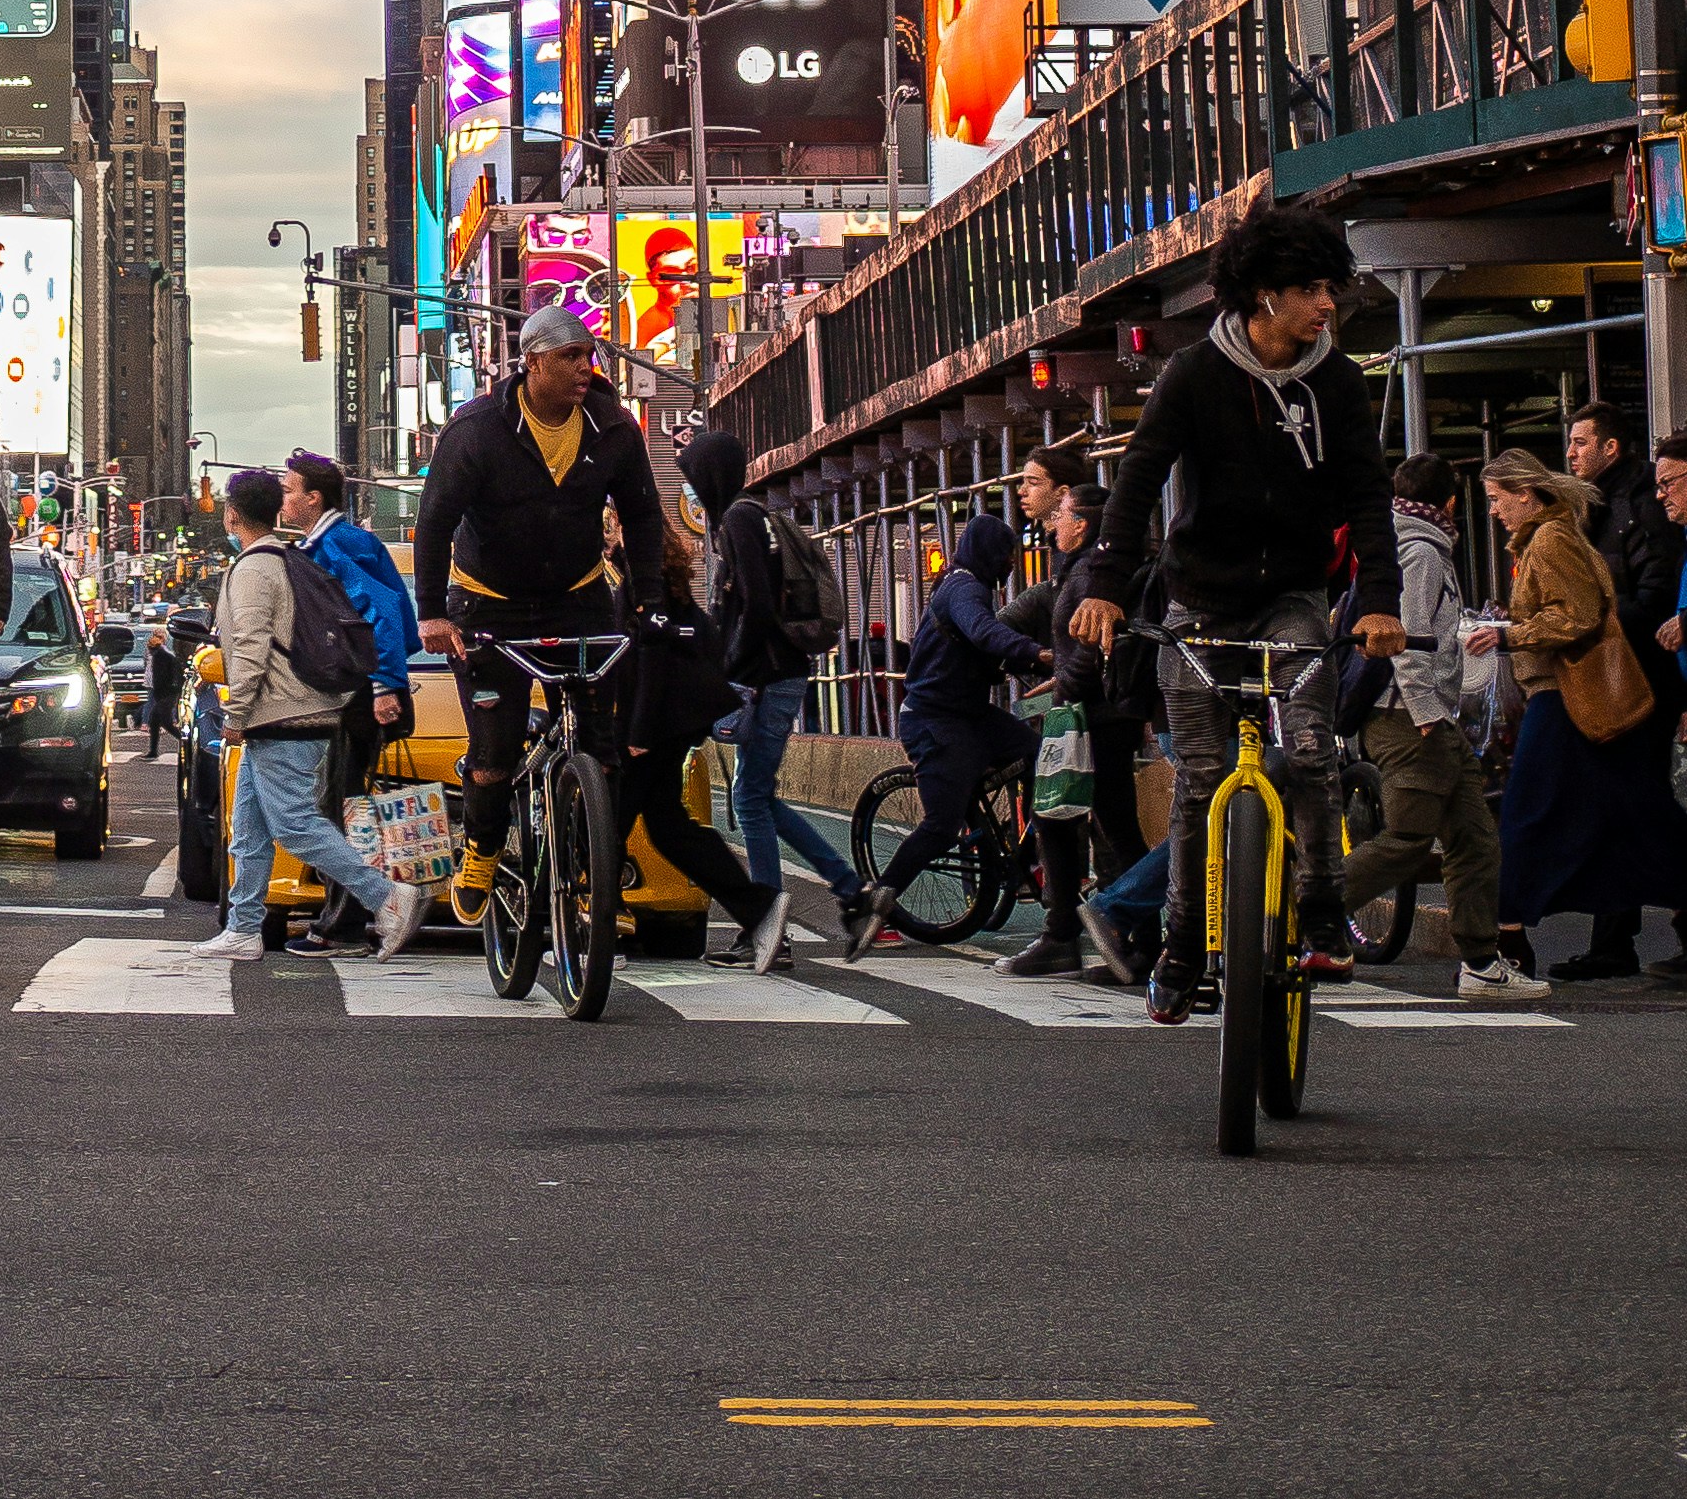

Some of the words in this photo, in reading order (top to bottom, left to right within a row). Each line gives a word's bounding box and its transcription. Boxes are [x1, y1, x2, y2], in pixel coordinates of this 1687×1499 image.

[778, 52, 821, 79] LG
[343, 309, 358, 423] WELLINGTON
[1208, 862, 1218, 882] GAS
